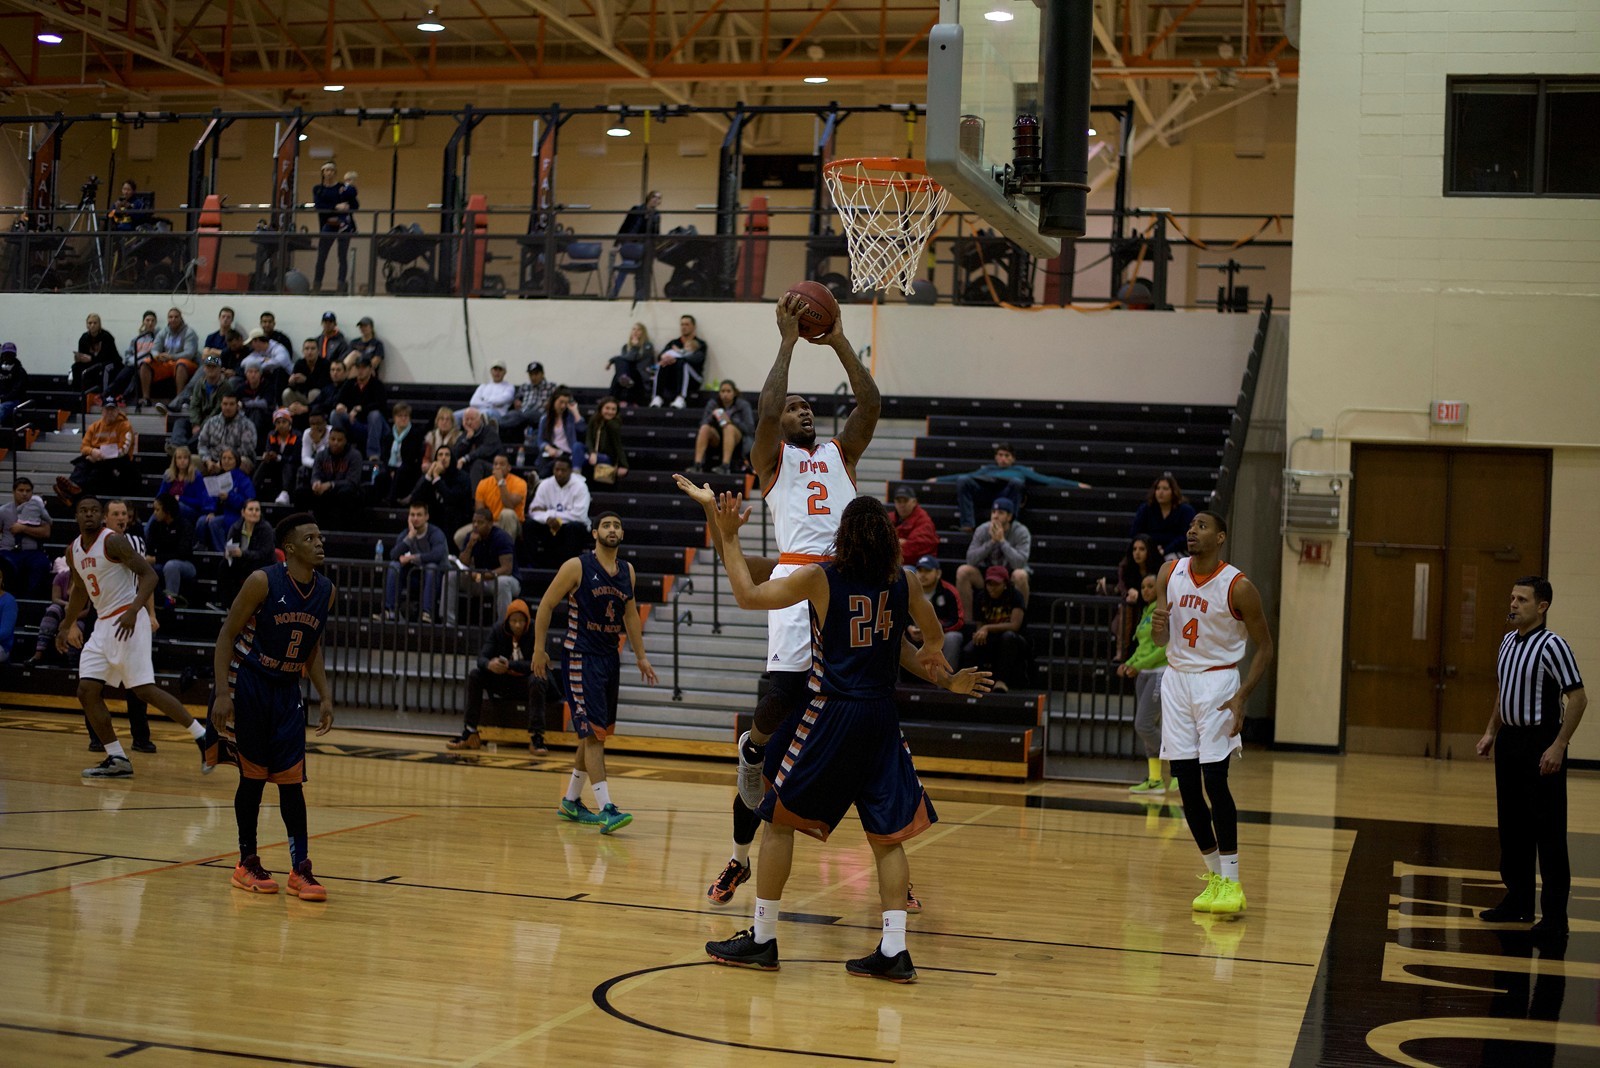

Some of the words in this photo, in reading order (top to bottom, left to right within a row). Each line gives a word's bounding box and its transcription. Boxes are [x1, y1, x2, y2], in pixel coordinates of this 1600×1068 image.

[1437, 402, 1461, 421] EXIT
[799, 459, 829, 474] UTPB
[807, 481, 831, 515] 2
[87, 573, 100, 597] 3
[605, 600, 616, 623] 4
[1179, 594, 1209, 614] UTPB
[848, 590, 894, 648] 24
[285, 629, 304, 659] 2
[1182, 617, 1200, 649] 4
